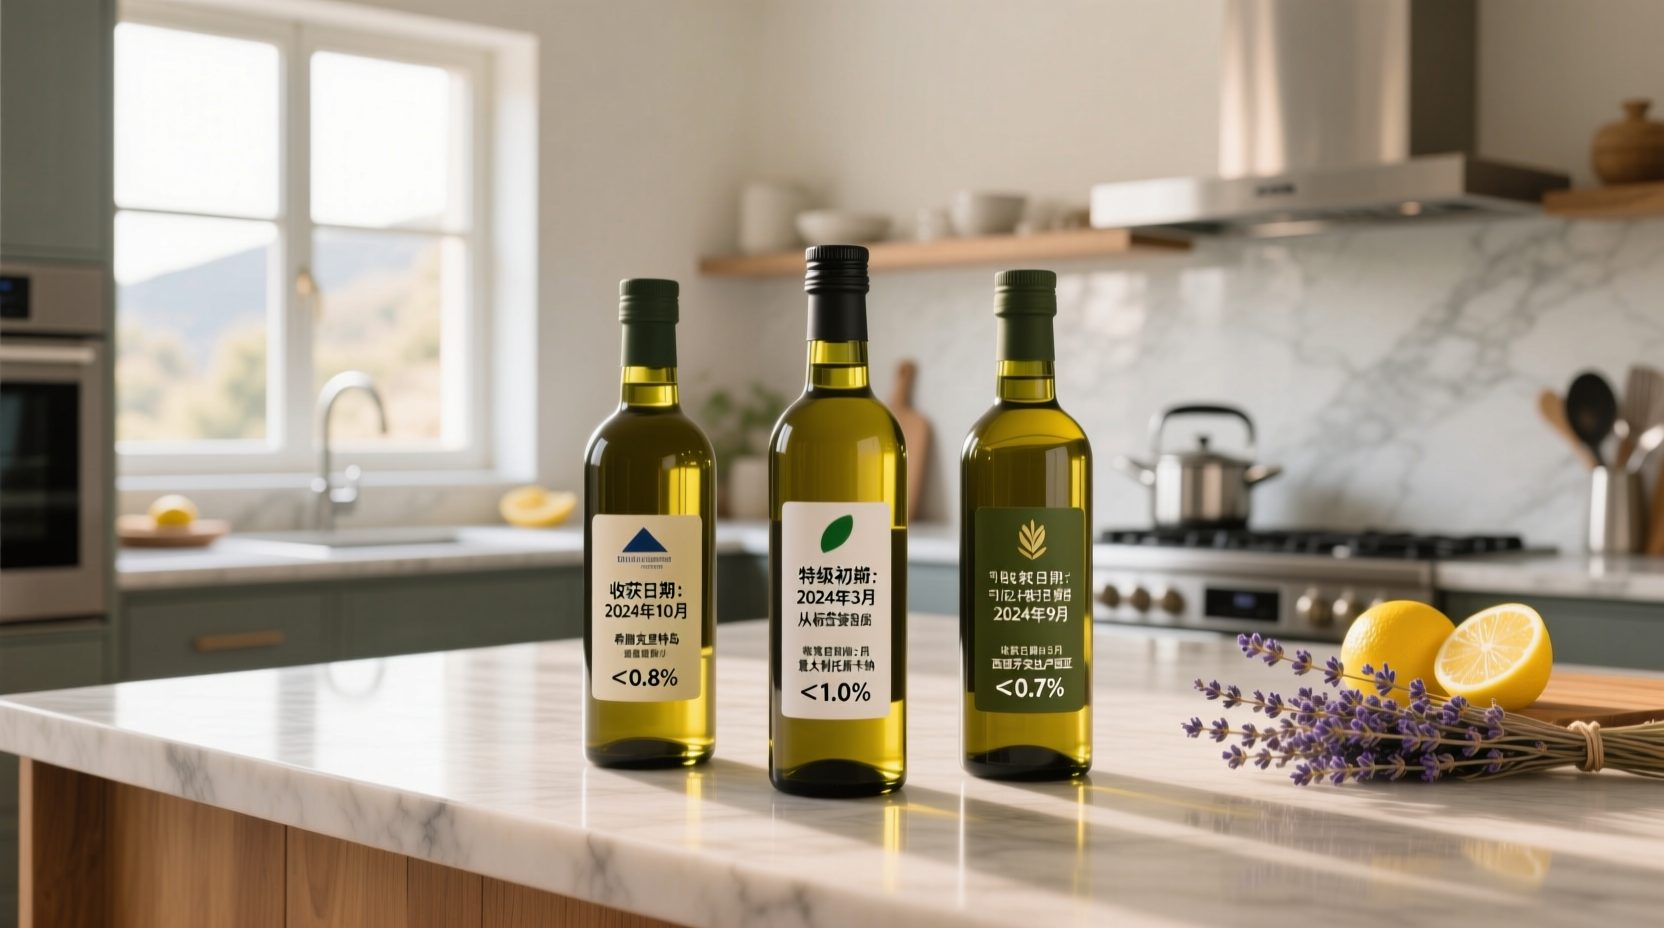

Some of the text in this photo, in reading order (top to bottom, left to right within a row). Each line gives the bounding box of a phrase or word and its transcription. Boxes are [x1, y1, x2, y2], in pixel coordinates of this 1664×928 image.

[797, 589, 875, 607] 2024年3月
[605, 603, 687, 620] 2024年10月
[993, 606, 1068, 623] 2024年9月
[612, 668, 678, 687] <0.8%
[801, 682, 871, 702] <1.0%
[996, 677, 1065, 698] <0.7%
